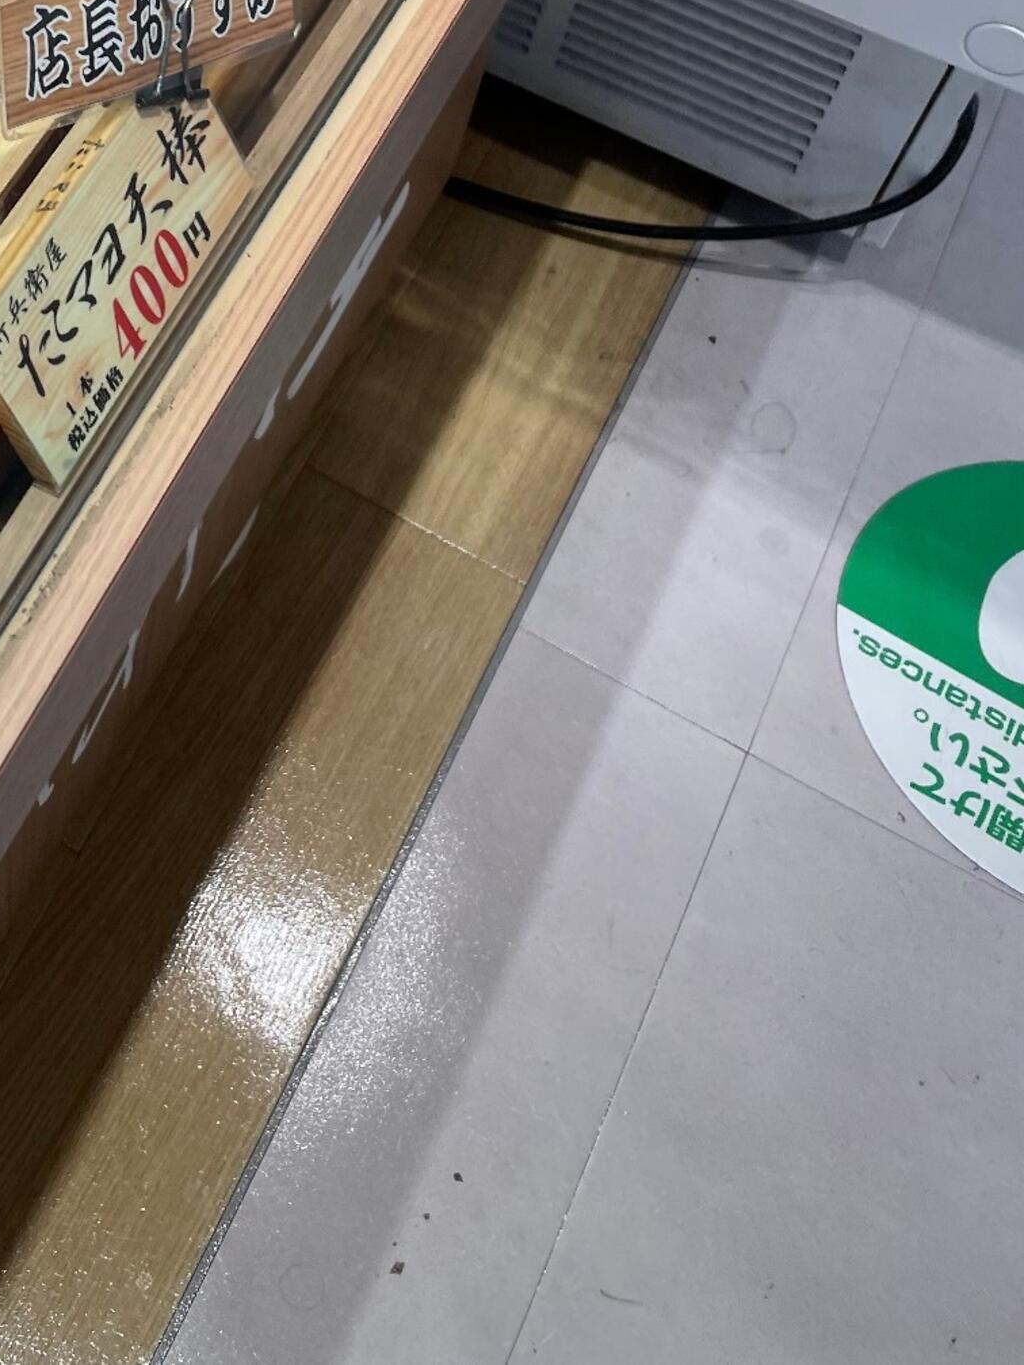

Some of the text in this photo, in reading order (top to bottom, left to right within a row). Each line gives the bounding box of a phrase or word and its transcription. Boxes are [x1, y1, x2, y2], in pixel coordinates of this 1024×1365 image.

[17, 106, 212, 398] たこマヨ天棒
[110, 210, 211, 363] 400円
[67, 365, 125, 453] 税込価格
